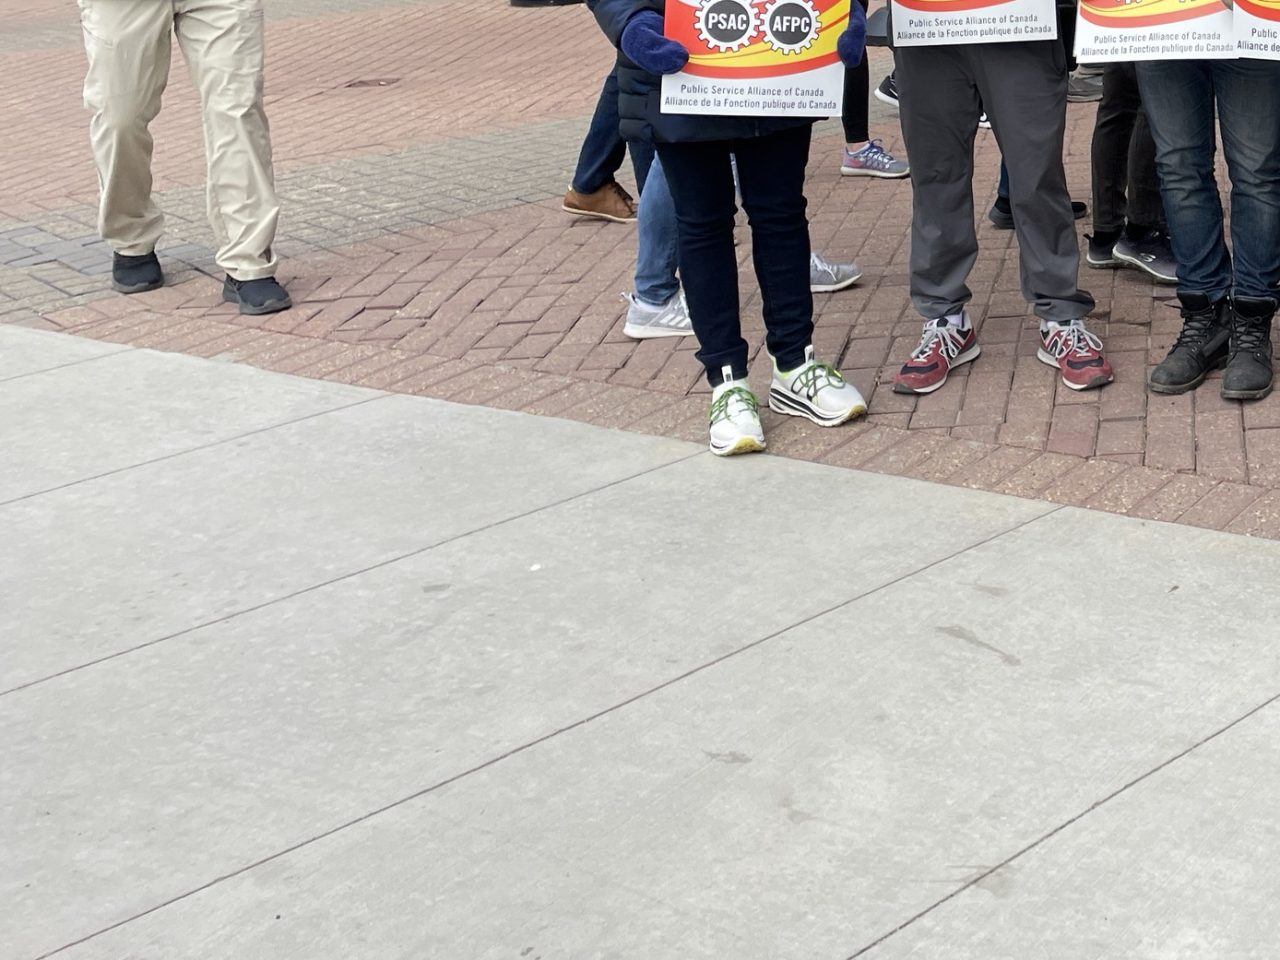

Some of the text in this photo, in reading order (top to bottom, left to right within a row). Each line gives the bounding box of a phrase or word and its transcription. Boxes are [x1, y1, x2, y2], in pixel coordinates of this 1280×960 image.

[707, 12, 747, 31] PSAC
[772, 15, 811, 34] AFPC
[909, 13, 1038, 28] Public Service Alliance of Canada
[897, 24, 1052, 40] Alliance de la Fonction publique du Canada
[1094, 31, 1221, 44] Public Service Alliance of Canada
[1251, 28, 1278, 39] Public
[1081, 42, 1234, 56] Alliance de la Fonction publique du Canada
[1237, 40, 1268, 51] Alliance
[1271, 42, 1280, 52] de
[681, 84, 824, 97] Public Service Alliance of Canada
[665, 96, 837, 110] Alliance de la Fonction publique du Canada
